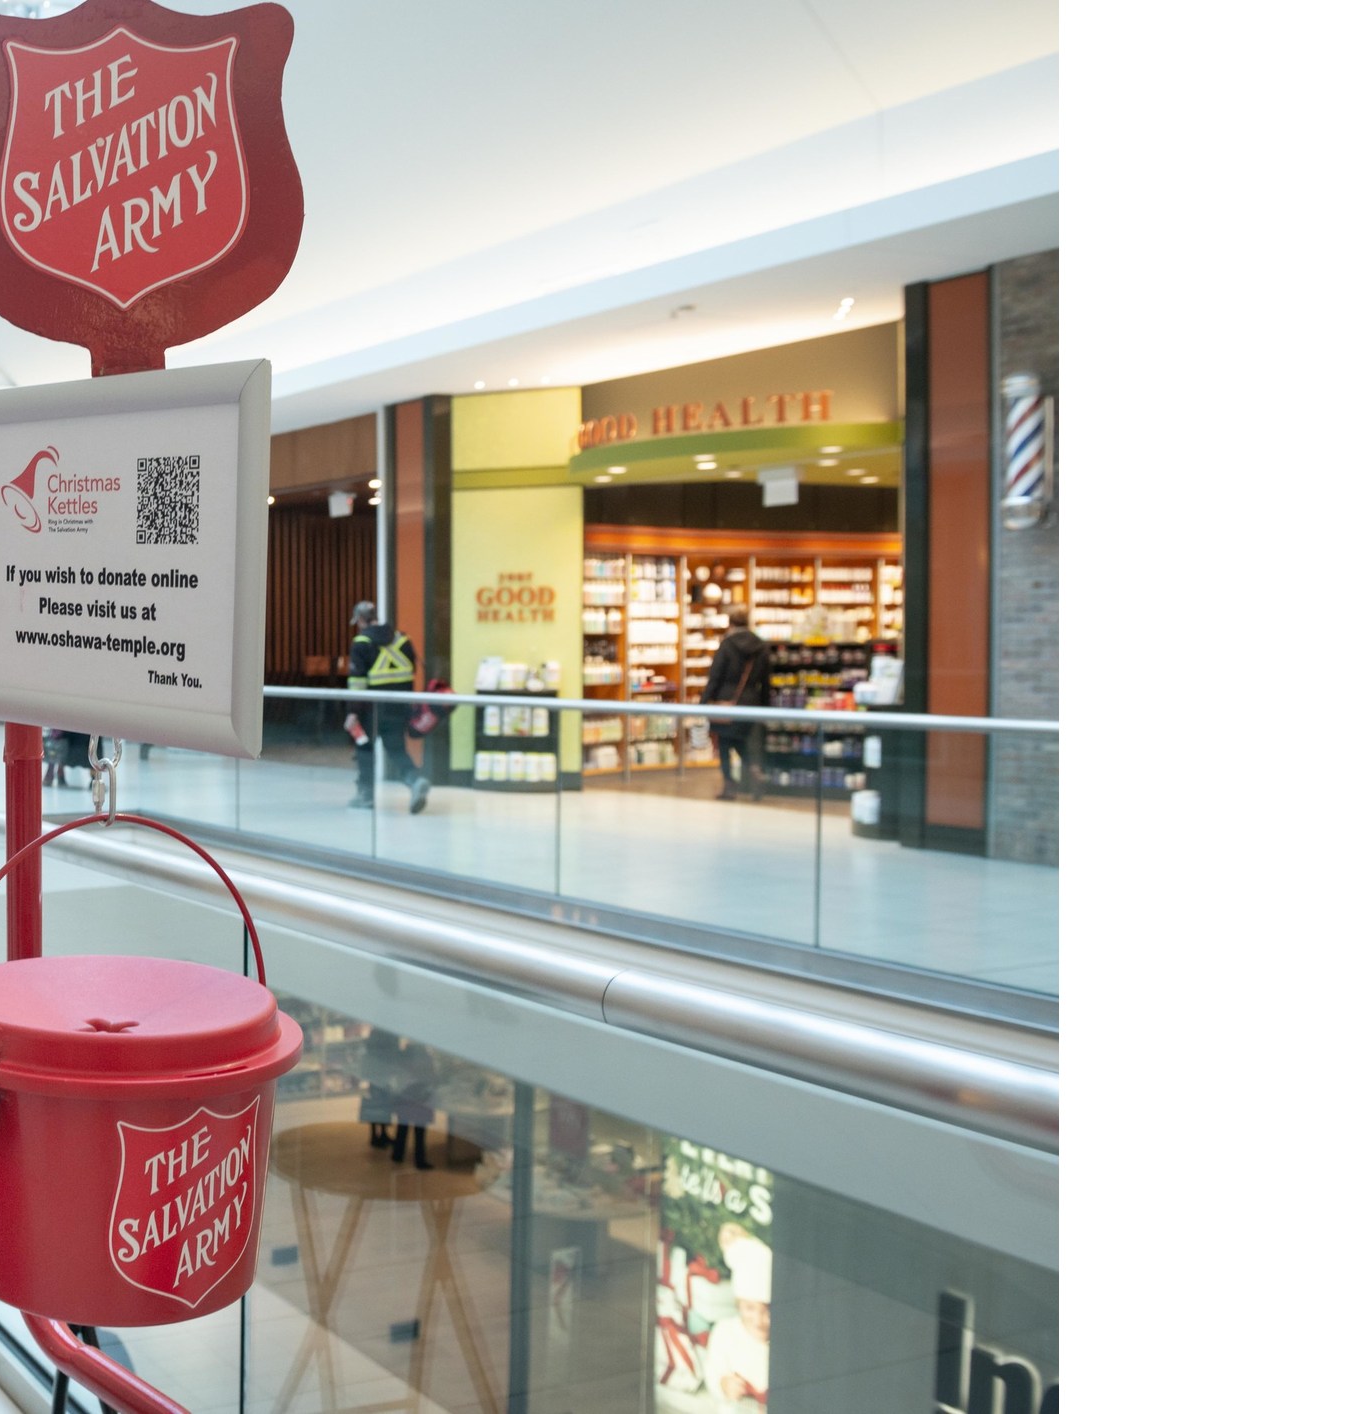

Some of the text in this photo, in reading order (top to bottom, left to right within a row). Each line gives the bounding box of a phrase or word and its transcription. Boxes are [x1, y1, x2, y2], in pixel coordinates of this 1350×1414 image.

[44, 54, 138, 140] THE
[13, 72, 218, 233] SALVATION
[90, 150, 218, 273] ARMY
[651, 389, 835, 437] HEALTH
[47, 474, 121, 493] Christmas
[48, 495, 98, 515] Kettles
[6, 565, 199, 589] If you wish to donate online
[476, 586, 556, 607] GOOD
[39, 597, 156, 621] Please visit us at
[477, 609, 556, 623] HEALTH
[16, 630, 186, 662] www.oshawa-temple.org
[148, 670, 202, 689] Thank You.
[144, 1126, 212, 1196] THE
[117, 1125, 252, 1263] SALVATION
[173, 1181, 247, 1288] ARMY
[933, 1287, 1058, 1414] In
